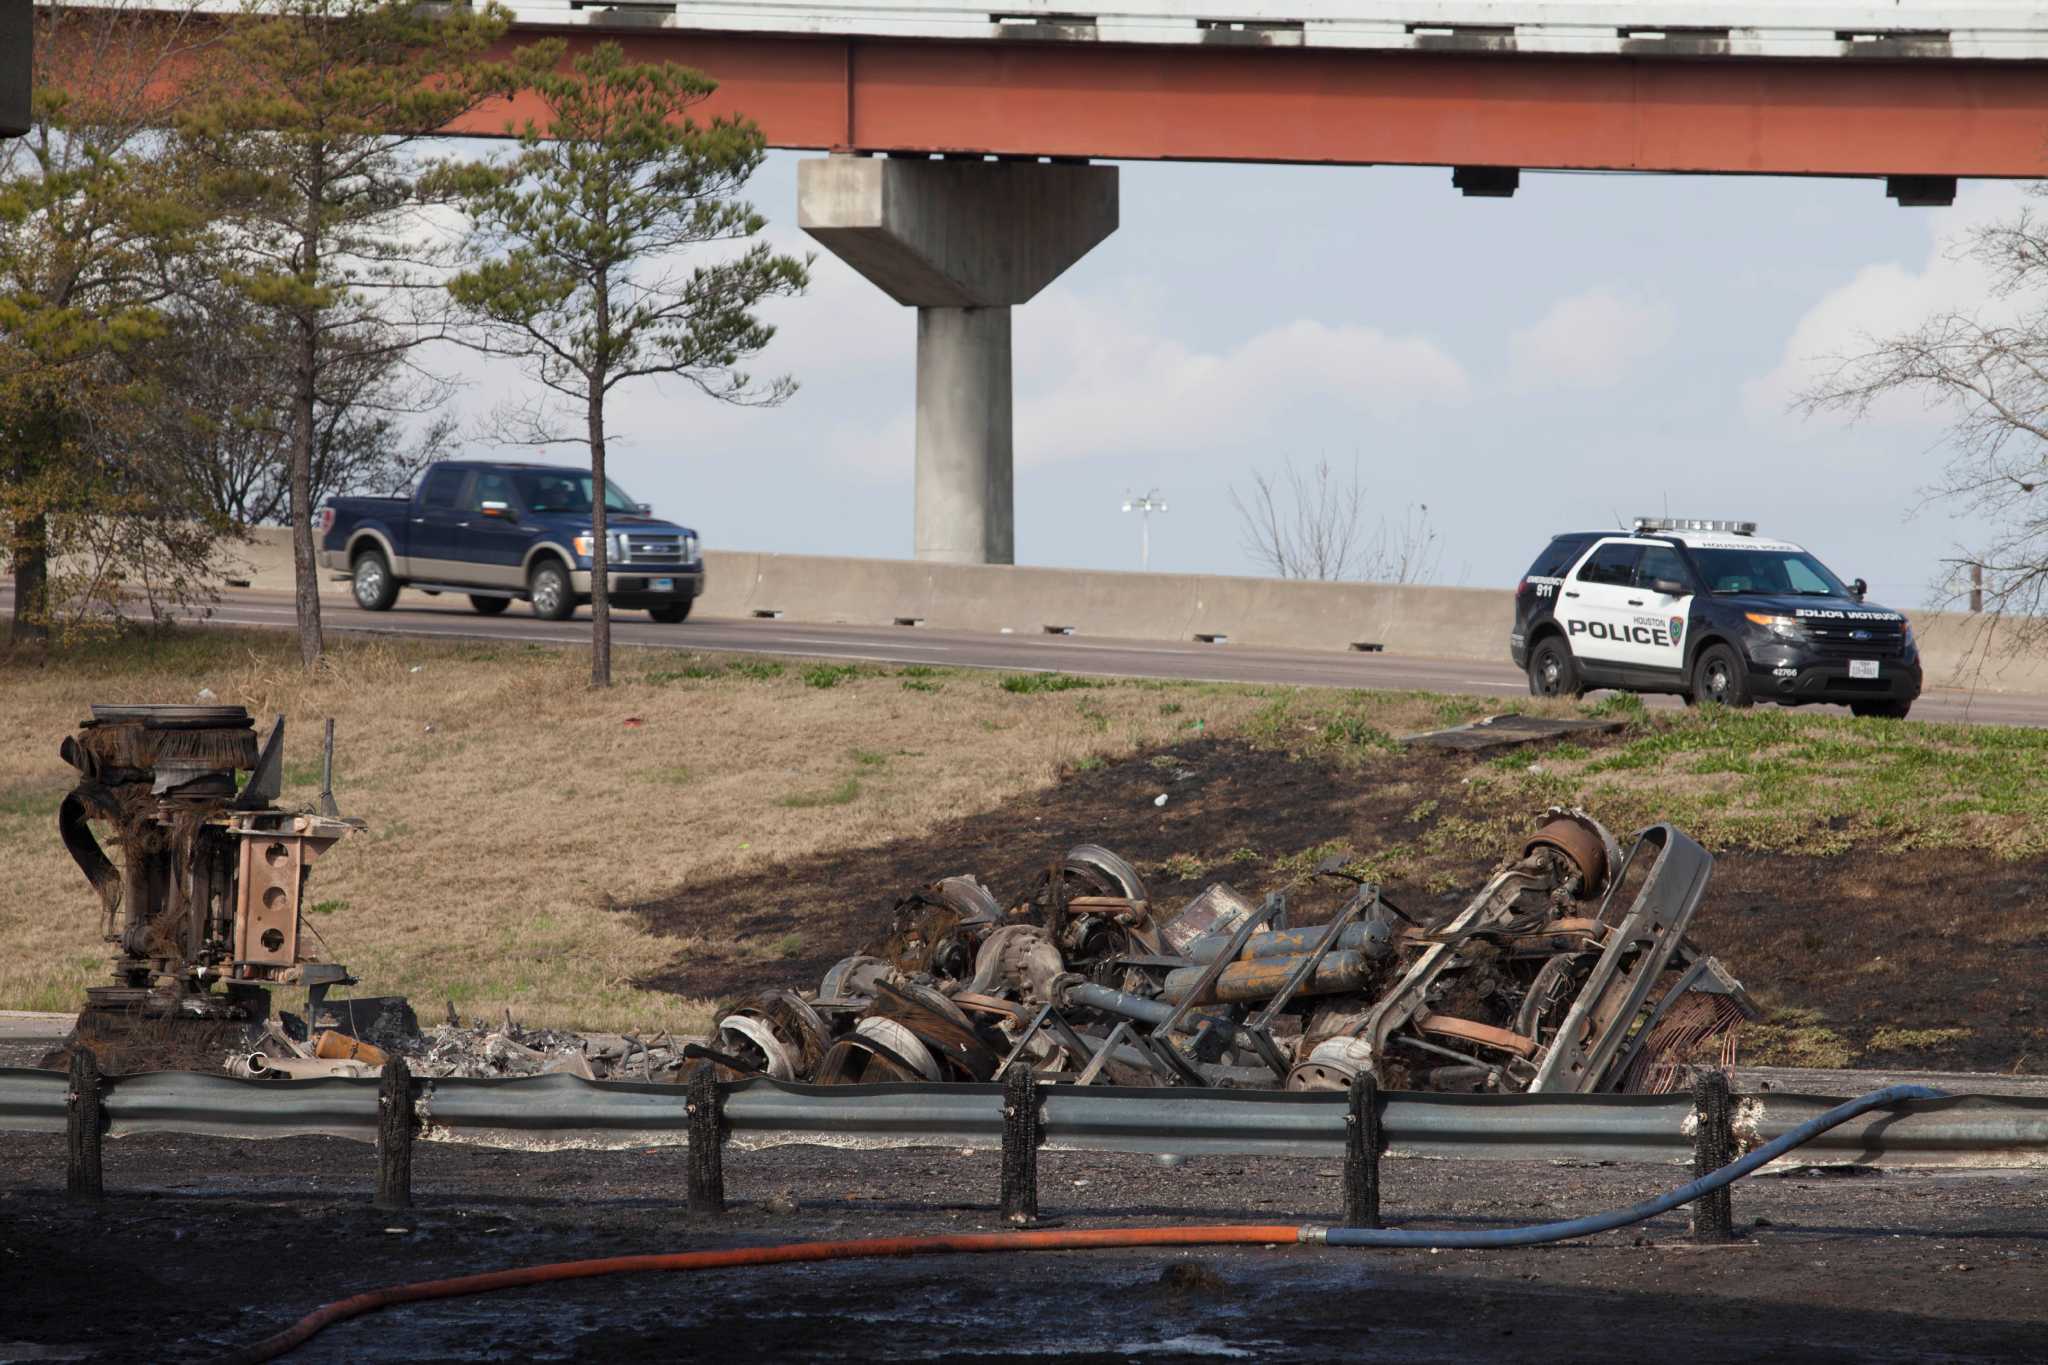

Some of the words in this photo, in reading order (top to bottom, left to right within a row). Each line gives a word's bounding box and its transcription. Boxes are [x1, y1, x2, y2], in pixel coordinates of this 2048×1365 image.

[1536, 584, 1553, 597] 911
[1633, 616, 1666, 627] HOUSTON
[1567, 619, 1670, 648] POLICE
